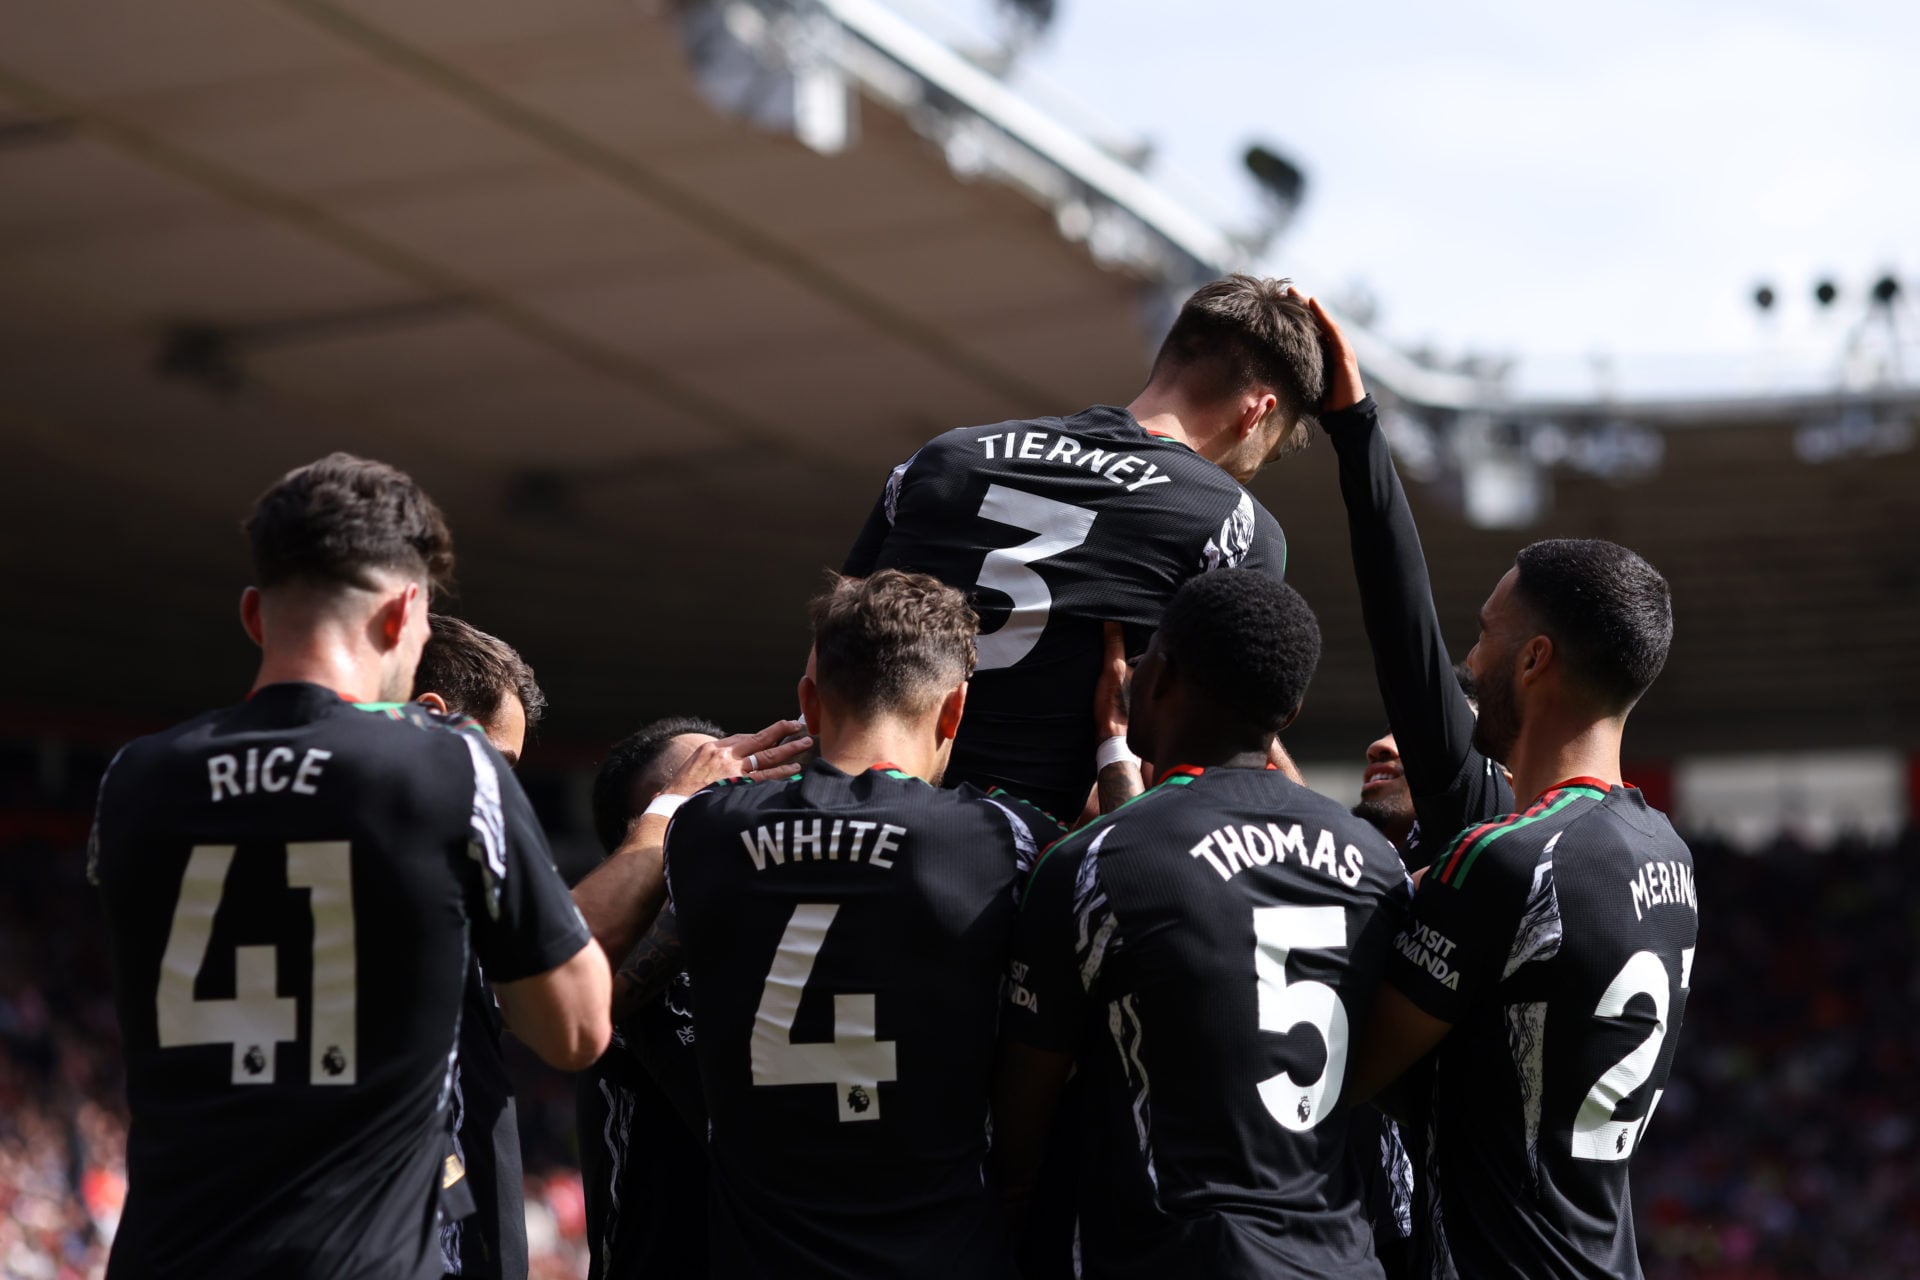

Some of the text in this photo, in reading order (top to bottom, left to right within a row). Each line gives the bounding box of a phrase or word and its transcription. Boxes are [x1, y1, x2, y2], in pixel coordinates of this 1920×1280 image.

[978, 432, 1171, 492] TIERNEY
[973, 483, 1098, 671] 3
[208, 747, 332, 801] RICE
[740, 818, 906, 871] WHITE
[1189, 823, 1363, 887] THOMAS
[156, 841, 356, 1085] 41
[1412, 919, 1457, 958] VISIT
[751, 904, 897, 1122] 4
[1253, 906, 1349, 1132] 5
